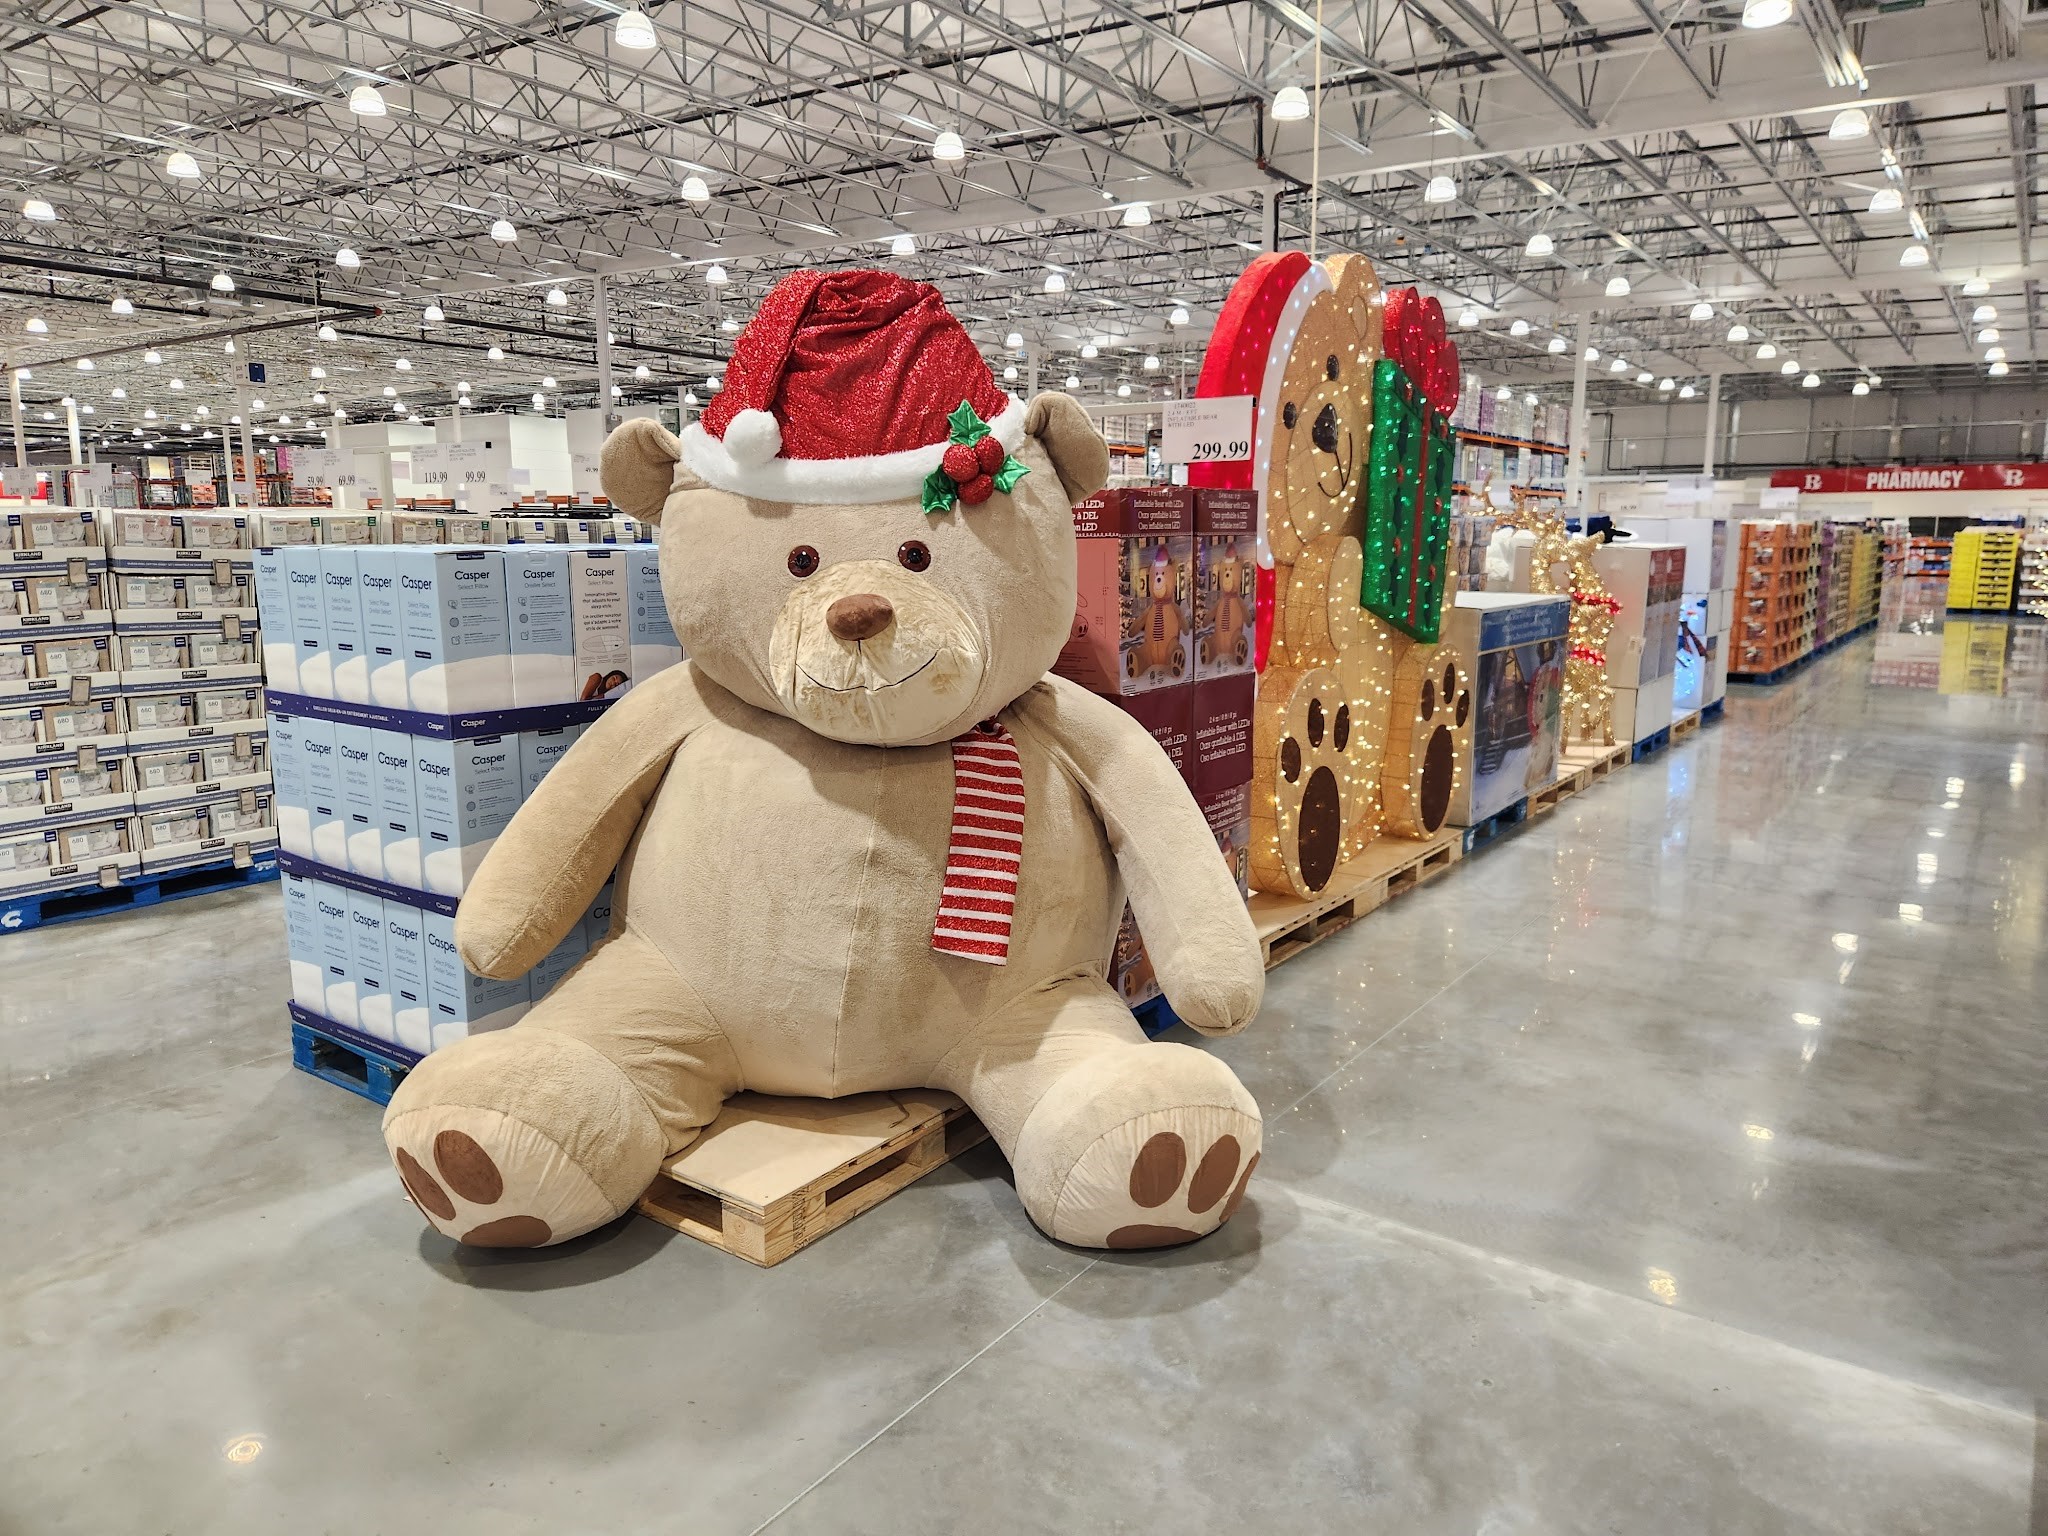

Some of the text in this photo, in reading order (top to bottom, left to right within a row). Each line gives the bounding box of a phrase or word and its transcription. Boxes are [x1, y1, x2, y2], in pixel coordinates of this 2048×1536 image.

[1191, 441, 1248, 461] 299.99
[307, 475, 324, 486] 59.99
[338, 474, 355, 486] 69.99
[424, 471, 448, 483] 119.99
[465, 470, 486, 482] 99.99
[1865, 470, 1964, 490] PHARMACY
[1085, 500, 1105, 508] LEDs
[1083, 511, 1099, 520] DEL
[1081, 522, 1098, 531] LED
[454, 570, 490, 582] Casper
[523, 569, 555, 581] Casper
[585, 568, 615, 579] Casper
[641, 566, 660, 578] Casp
[290, 571, 317, 587] Casper
[325, 572, 353, 589] Casper
[363, 574, 392, 591] Casper
[401, 575, 432, 593] Casper
[427, 721, 444, 731] Casper
[460, 719, 486, 728] Casper
[1238, 719, 1251, 729] LEDs
[1173, 733, 1188, 745] LEDs
[1236, 731, 1247, 741] DEL
[305, 740, 331, 757] Casper
[341, 745, 368, 763] Casper
[536, 744, 567, 755] Casper
[1172, 747, 1183, 758] DEL
[1236, 743, 1246, 753] LED
[378, 752, 407, 770] Casper
[472, 754, 506, 765] Casper
[419, 759, 450, 778] Casper
[46, 803, 72, 811] KIRKLAND
[51, 865, 77, 873] KIRKLAND
[319, 901, 345, 919] Casper
[353, 911, 380, 930] Casper
[390, 921, 418, 942] Casper
